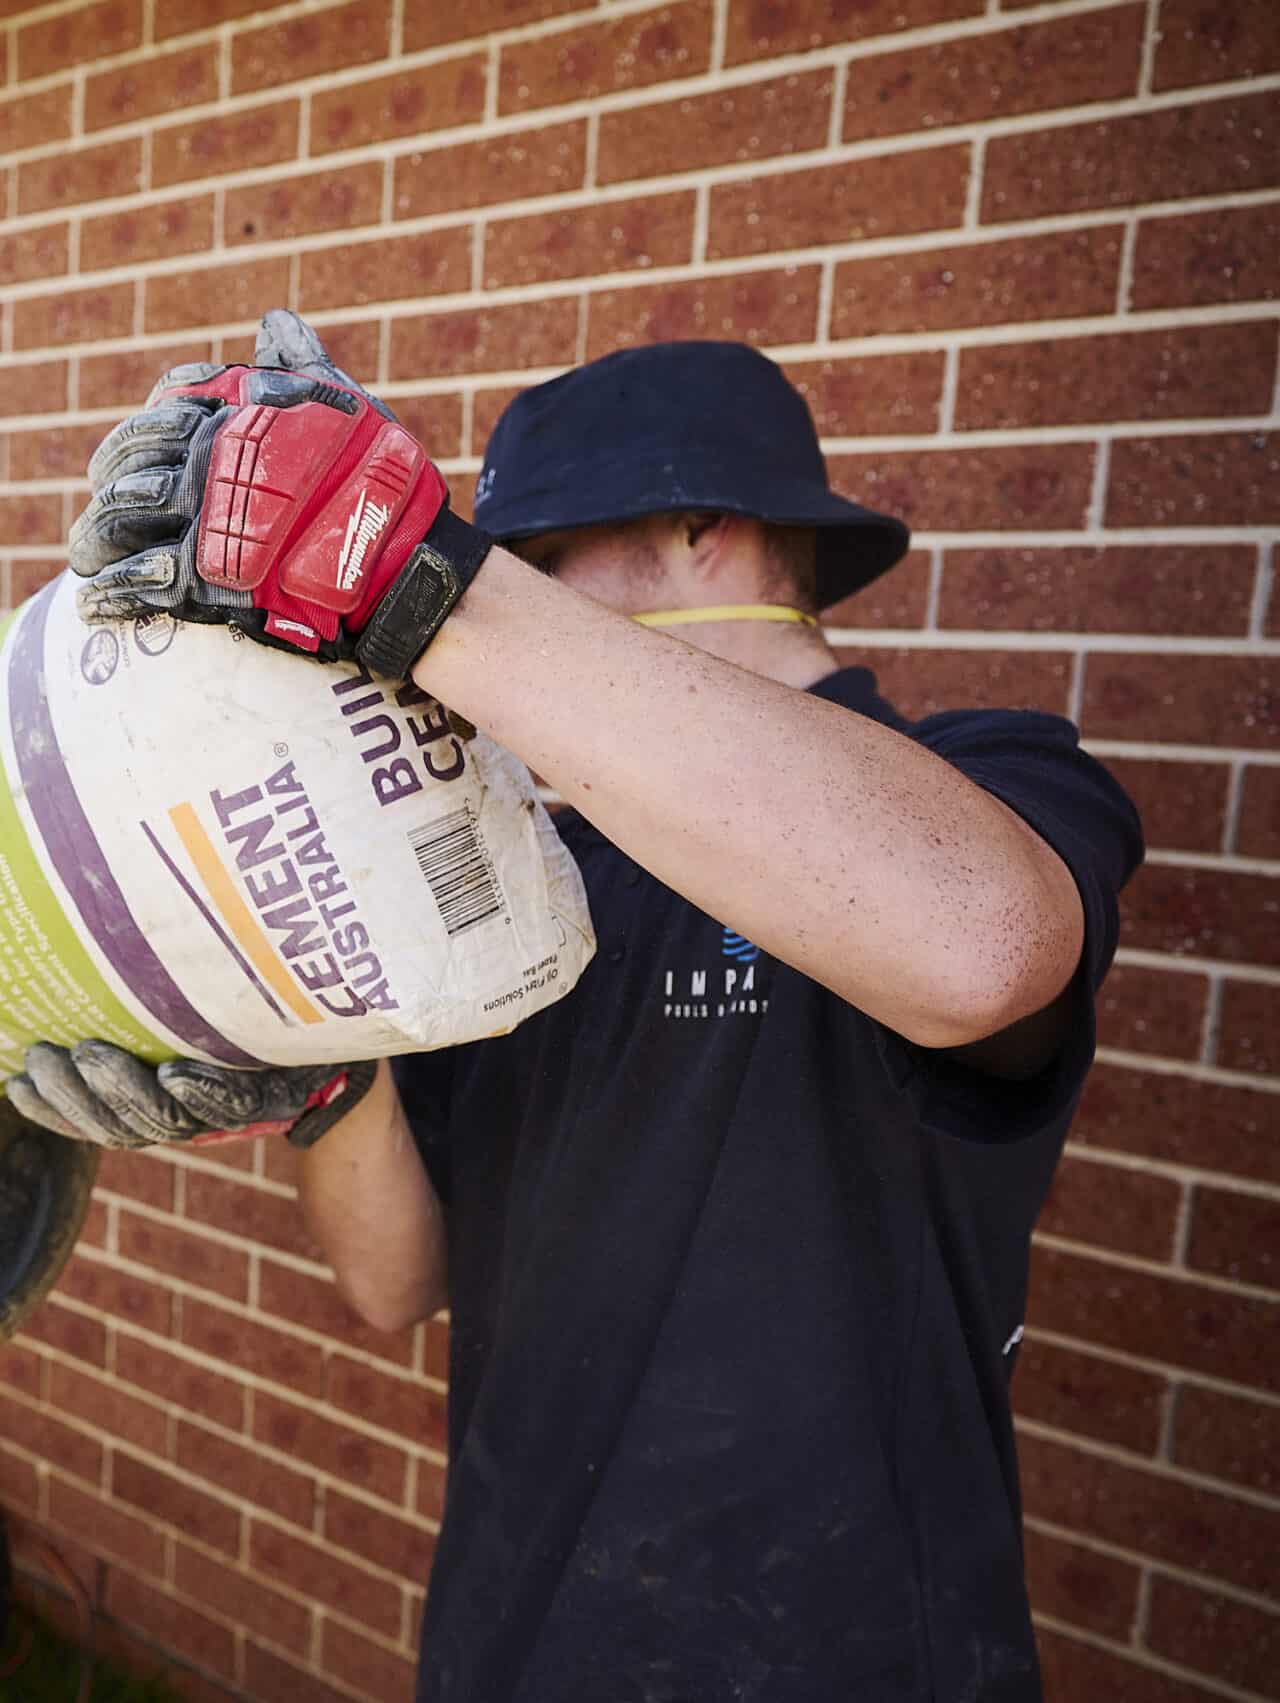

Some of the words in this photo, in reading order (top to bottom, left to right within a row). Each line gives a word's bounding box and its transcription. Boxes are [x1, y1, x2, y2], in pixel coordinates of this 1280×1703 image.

[331, 664, 424, 807] BUIL
[209, 785, 368, 1017] CEMENT
[264, 760, 400, 1010] AUSTRALIA
[483, 985, 525, 1012] Solutions
[664, 965, 755, 996] IMPA
